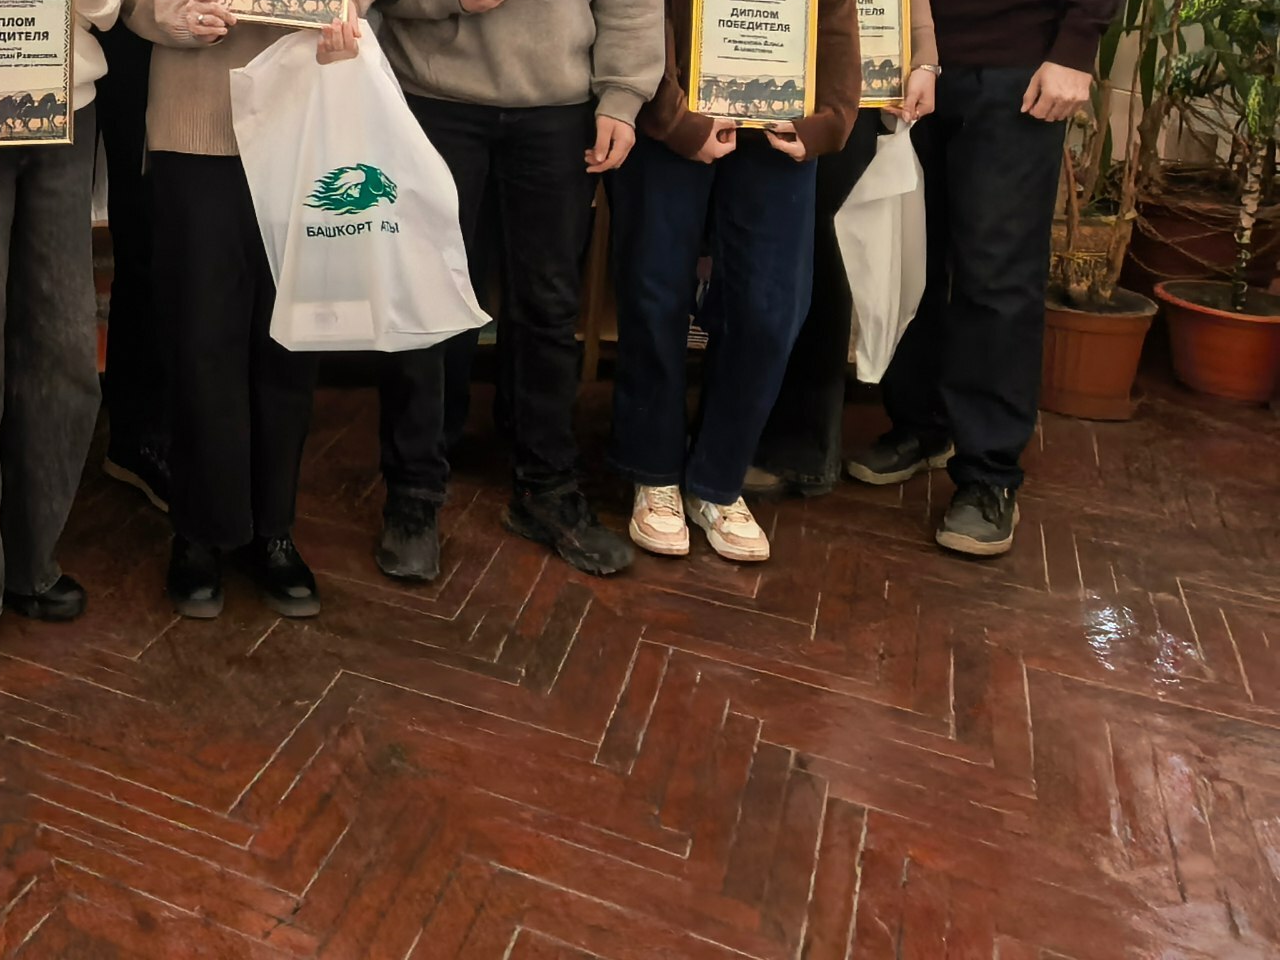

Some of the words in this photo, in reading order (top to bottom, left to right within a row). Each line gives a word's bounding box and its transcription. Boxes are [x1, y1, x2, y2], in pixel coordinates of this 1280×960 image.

[730, 7, 780, 20] ДИПЛОМ
[718, 19, 791, 33] ПОБЕДИТЕЛЯ
[380, 220, 400, 234] АТЫ
